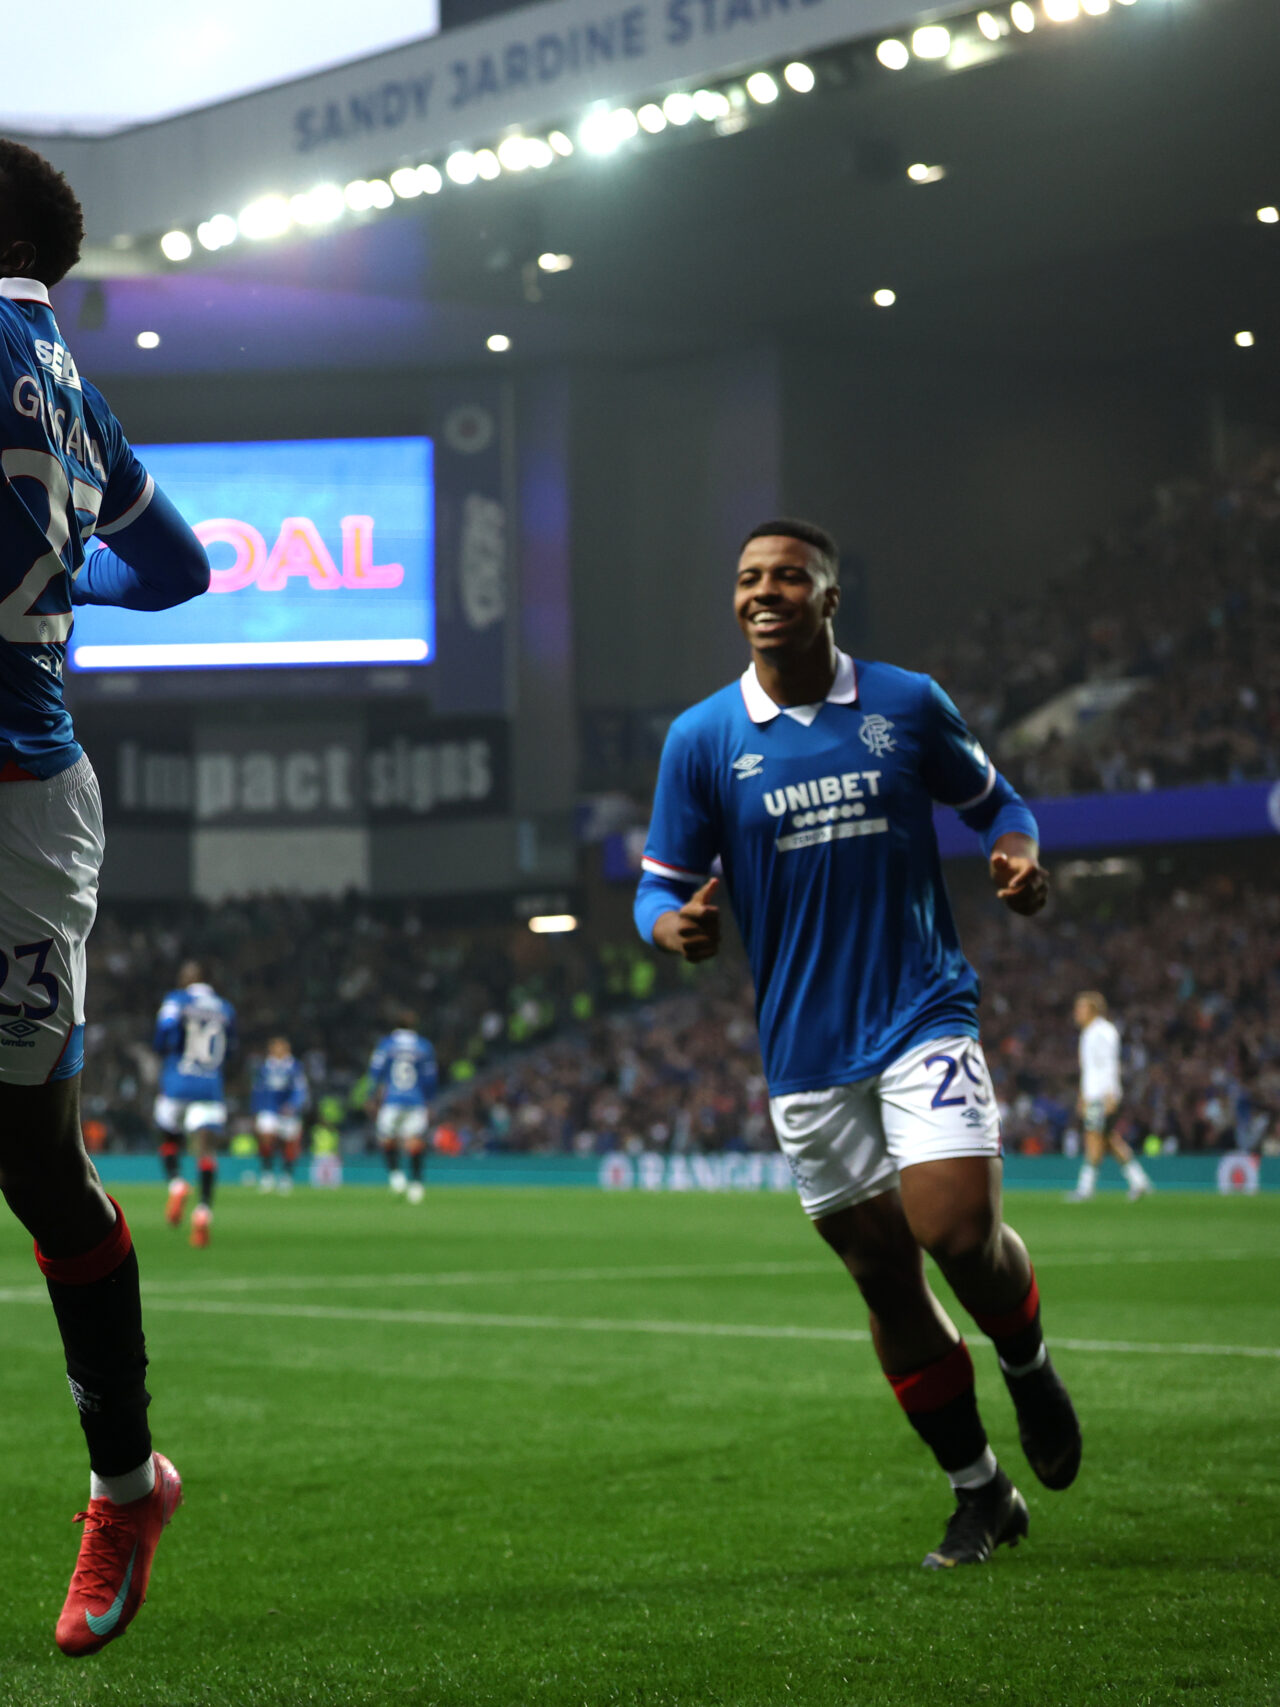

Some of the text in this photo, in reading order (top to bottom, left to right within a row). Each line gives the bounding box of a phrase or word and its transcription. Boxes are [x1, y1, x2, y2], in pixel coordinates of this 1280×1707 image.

[293, 71, 433, 152] SANDY
[448, 9, 644, 109] JARDINE
[194, 515, 405, 593] OAL
[763, 769, 882, 817] UNIBET
[1, 1038, 36, 1048] umbro
